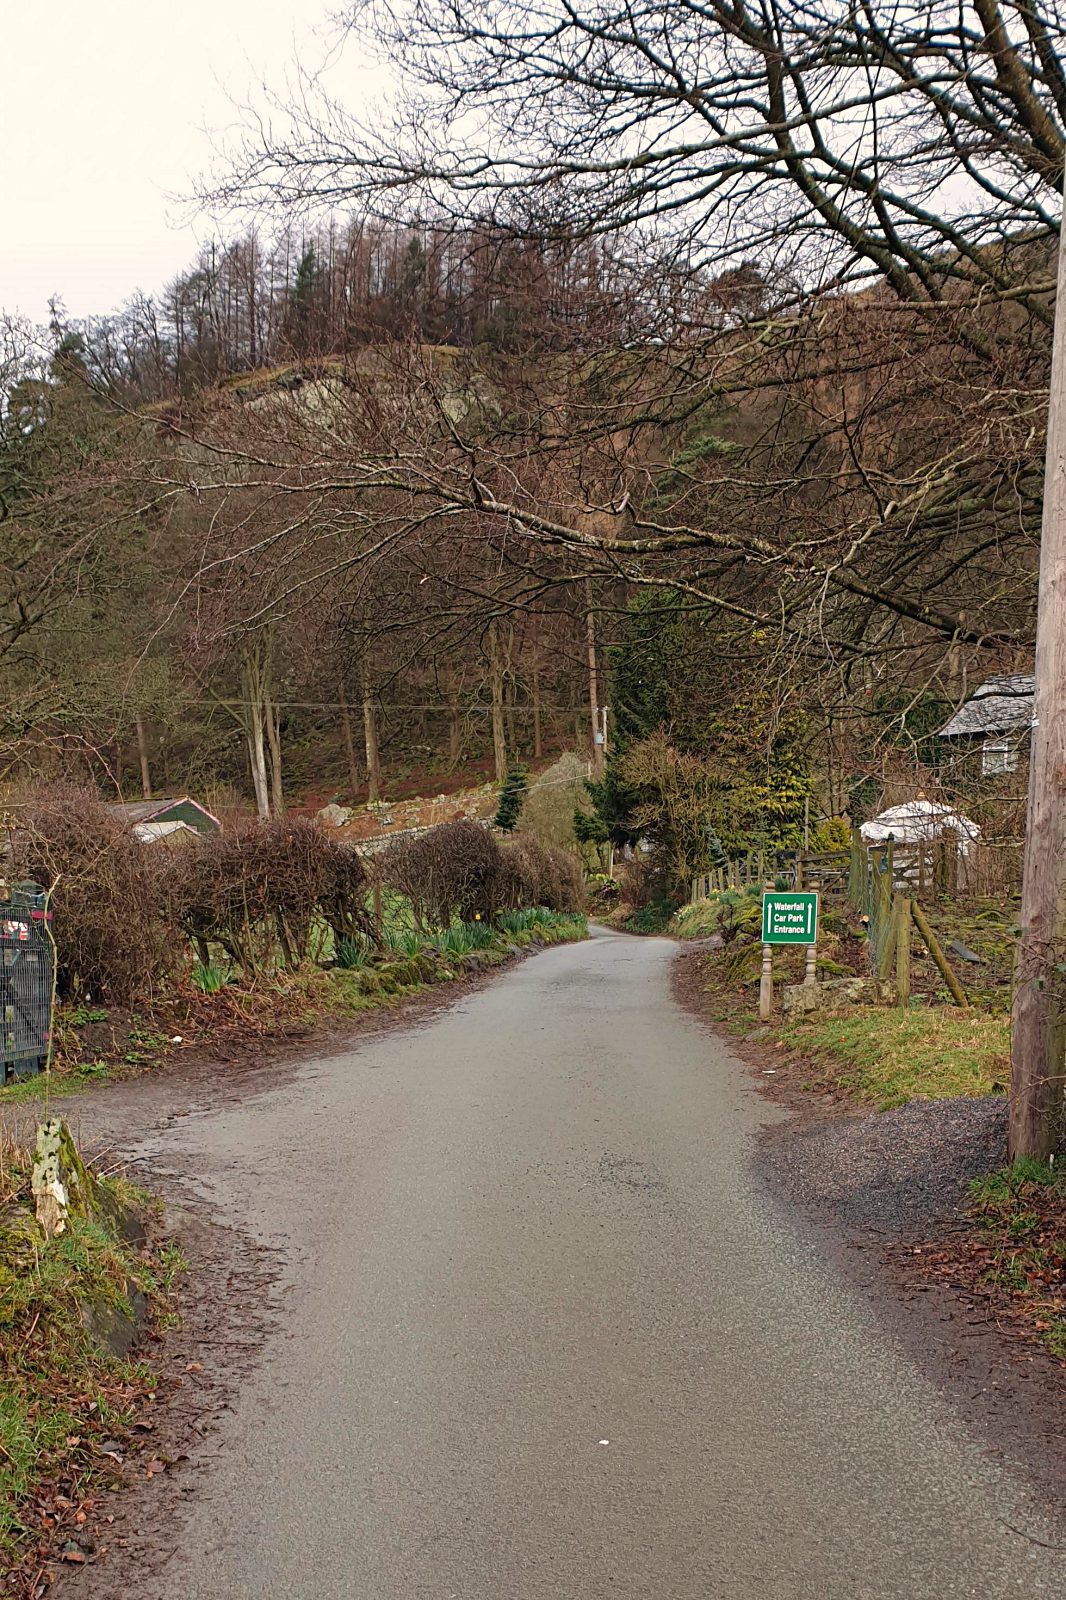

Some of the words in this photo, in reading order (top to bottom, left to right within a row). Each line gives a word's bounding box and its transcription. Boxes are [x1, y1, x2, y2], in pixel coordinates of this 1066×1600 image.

[774, 902, 804, 910] Waterfall
[774, 914, 786, 922] Car
[788, 914, 803, 922] Park
[774, 925, 805, 933] Entrance
